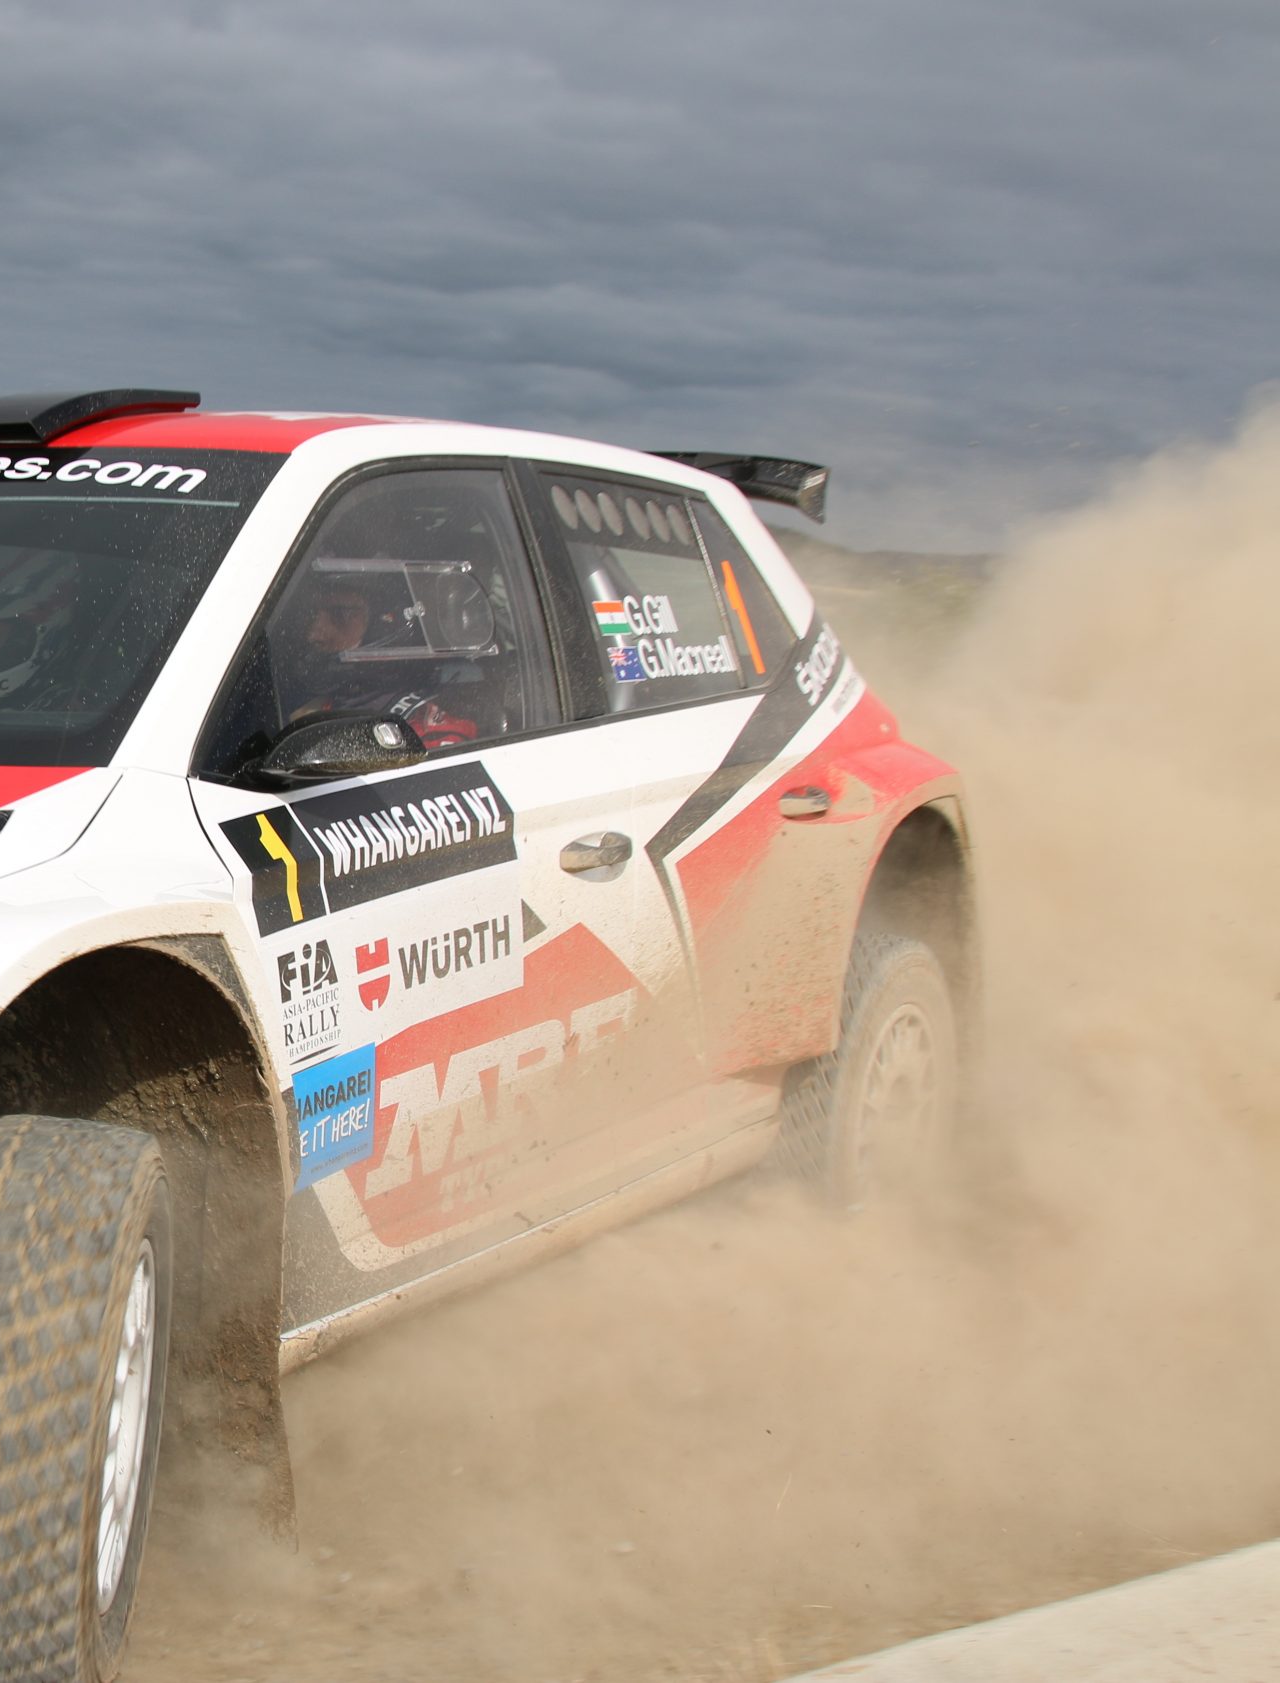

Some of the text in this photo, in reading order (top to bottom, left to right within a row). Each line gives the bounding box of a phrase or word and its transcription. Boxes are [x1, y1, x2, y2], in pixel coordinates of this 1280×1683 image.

[313, 786, 506, 878] WHANGAREI NZ
[256, 813, 304, 922] 1
[398, 915, 510, 989] WÜRTH
[284, 1004, 340, 1047] RALLY
[289, 1029, 342, 1058] HAMPIONSHIP
[297, 1068, 371, 1122] ANGAREI
[312, 1114, 331, 1153] IT
[331, 1097, 371, 1143] HERE!
